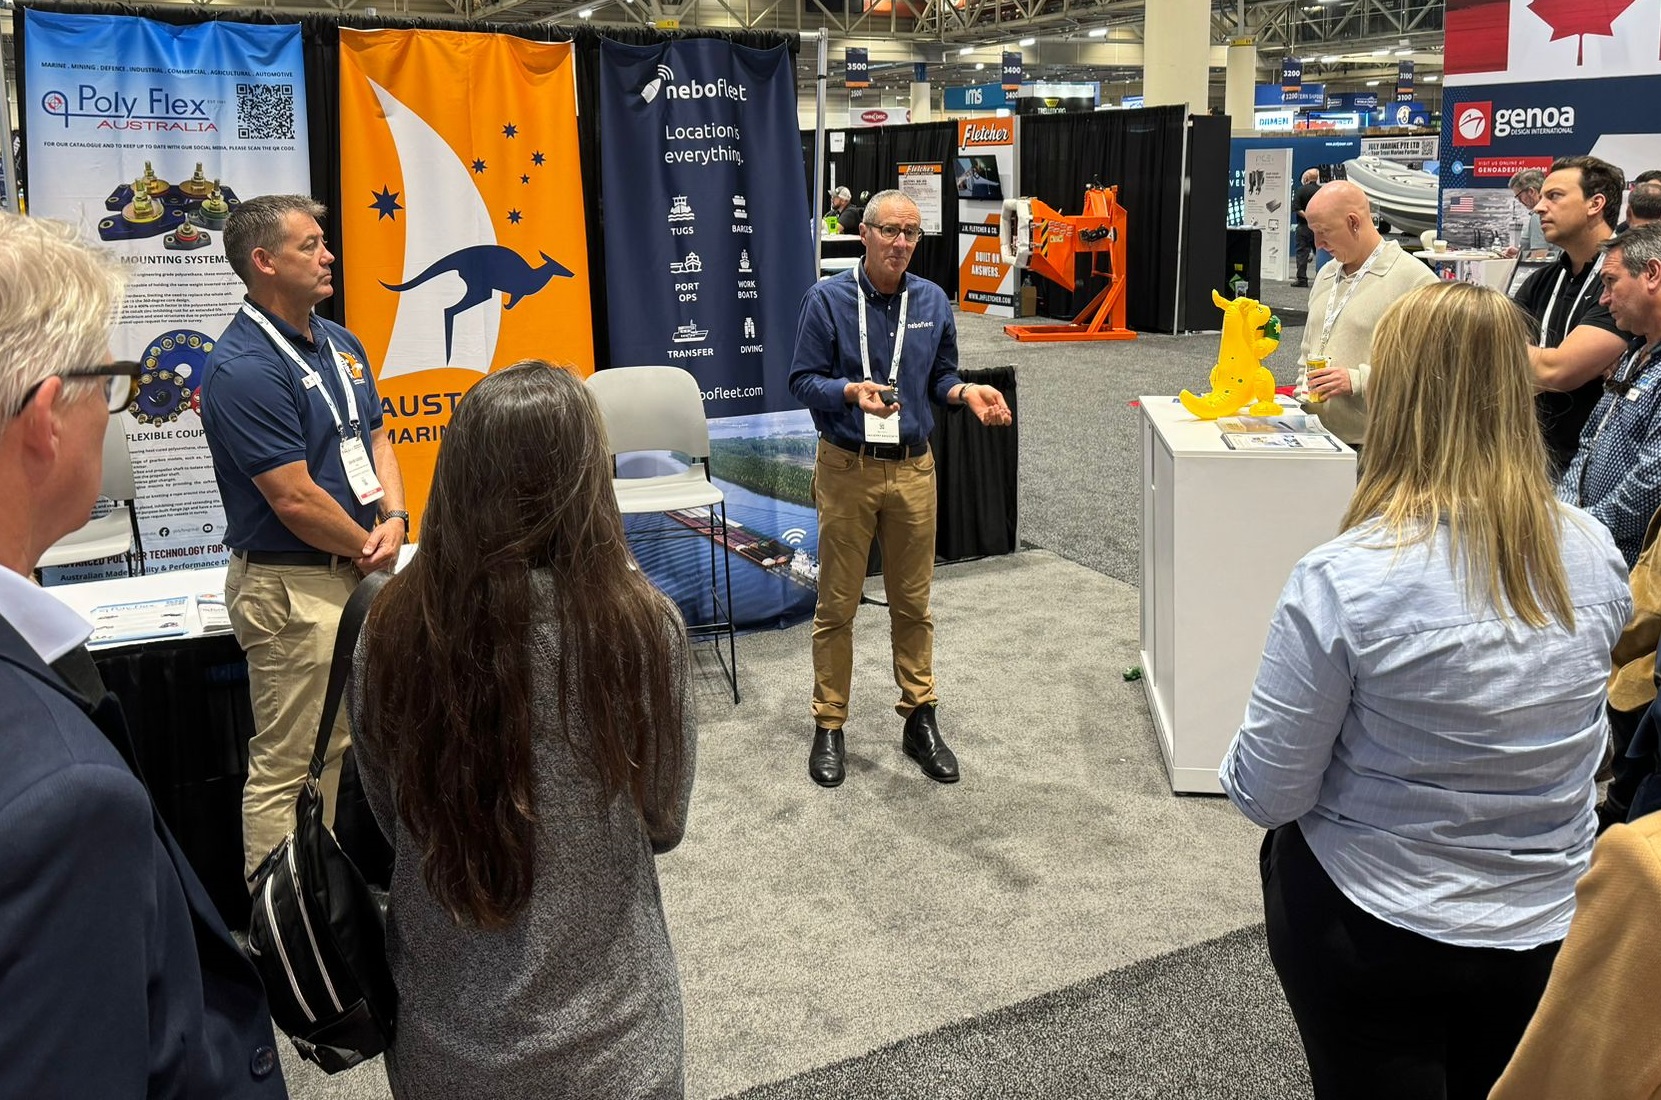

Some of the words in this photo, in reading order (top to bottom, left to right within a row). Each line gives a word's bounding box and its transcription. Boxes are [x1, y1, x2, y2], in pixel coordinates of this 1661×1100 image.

[847, 62, 867, 71] 3500
[1003, 66, 1022, 74] 3400
[666, 78, 748, 101] nebofleet
[79, 84, 138, 118] Poly
[149, 88, 206, 116] Flex
[96, 120, 218, 132] AUSTRALIA
[1495, 106, 1575, 137] genoa
[666, 122, 734, 140] Location
[734, 124, 740, 140] is
[1531, 126, 1574, 135] INTERNATIONAL
[962, 123, 1009, 150] Fletcher
[1380, 142, 1398, 150] MARINE
[1410, 141, 1420, 149] LTD
[664, 144, 744, 166] everything.
[670, 226, 694, 236] TUGS
[121, 256, 182, 264] MOUNTING
[184, 255, 229, 264] SYSTEMS
[972, 264, 1000, 278] ANSWERS.
[675, 282, 700, 292] PORT
[738, 280, 756, 288] WORK
[678, 293, 698, 302] OPS
[738, 290, 758, 299] BOATS
[667, 348, 714, 359] TRANSFER
[740, 344, 763, 354] DIVING
[380, 392, 462, 418] AUST
[126, 430, 172, 442] FLEXIBLE
[150, 546, 205, 560] TECHNOLOGY
[208, 544, 224, 554] FOR
[60, 569, 104, 581] Australian
[106, 570, 128, 578] Made
[168, 560, 220, 570] Performance
